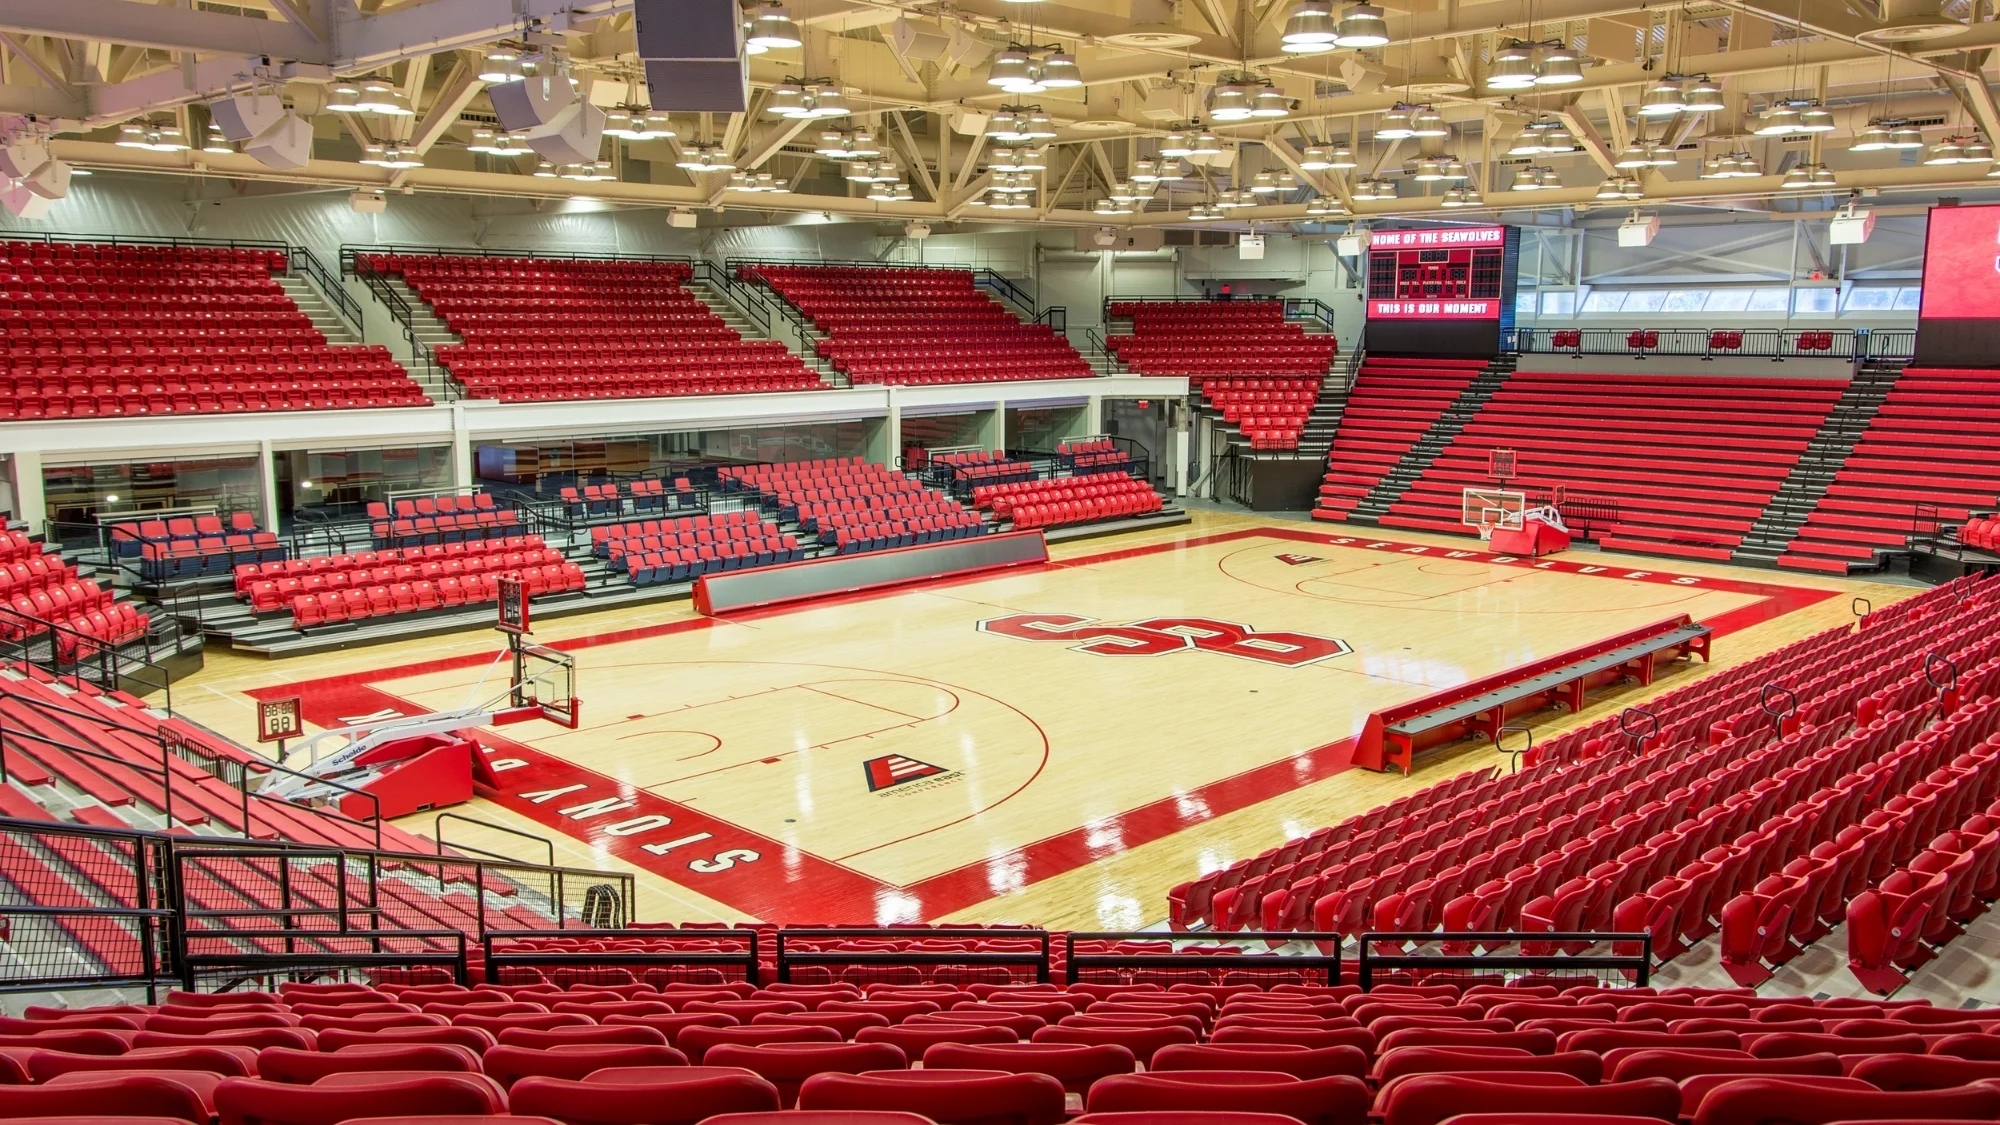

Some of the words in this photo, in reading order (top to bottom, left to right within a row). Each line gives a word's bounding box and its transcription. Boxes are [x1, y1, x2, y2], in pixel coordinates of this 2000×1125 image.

[1372, 234, 1400, 246] HOME
[1403, 233, 1416, 244] OF
[1419, 232, 1438, 243] THE
[1441, 230, 1500, 242] SEAWOLVES
[1377, 303, 1400, 314] THIS
[1404, 303, 1415, 314] IS
[1418, 303, 1440, 314] OUR
[1443, 303, 1487, 314] MOMENT
[1330, 536, 1701, 585] SEAWOLVES
[332, 745, 367, 766] Schelde
[878, 781, 934, 798] america
[933, 771, 965, 783] east
[898, 778, 964, 798] CONFERENCE
[518, 783, 761, 873] STONY
